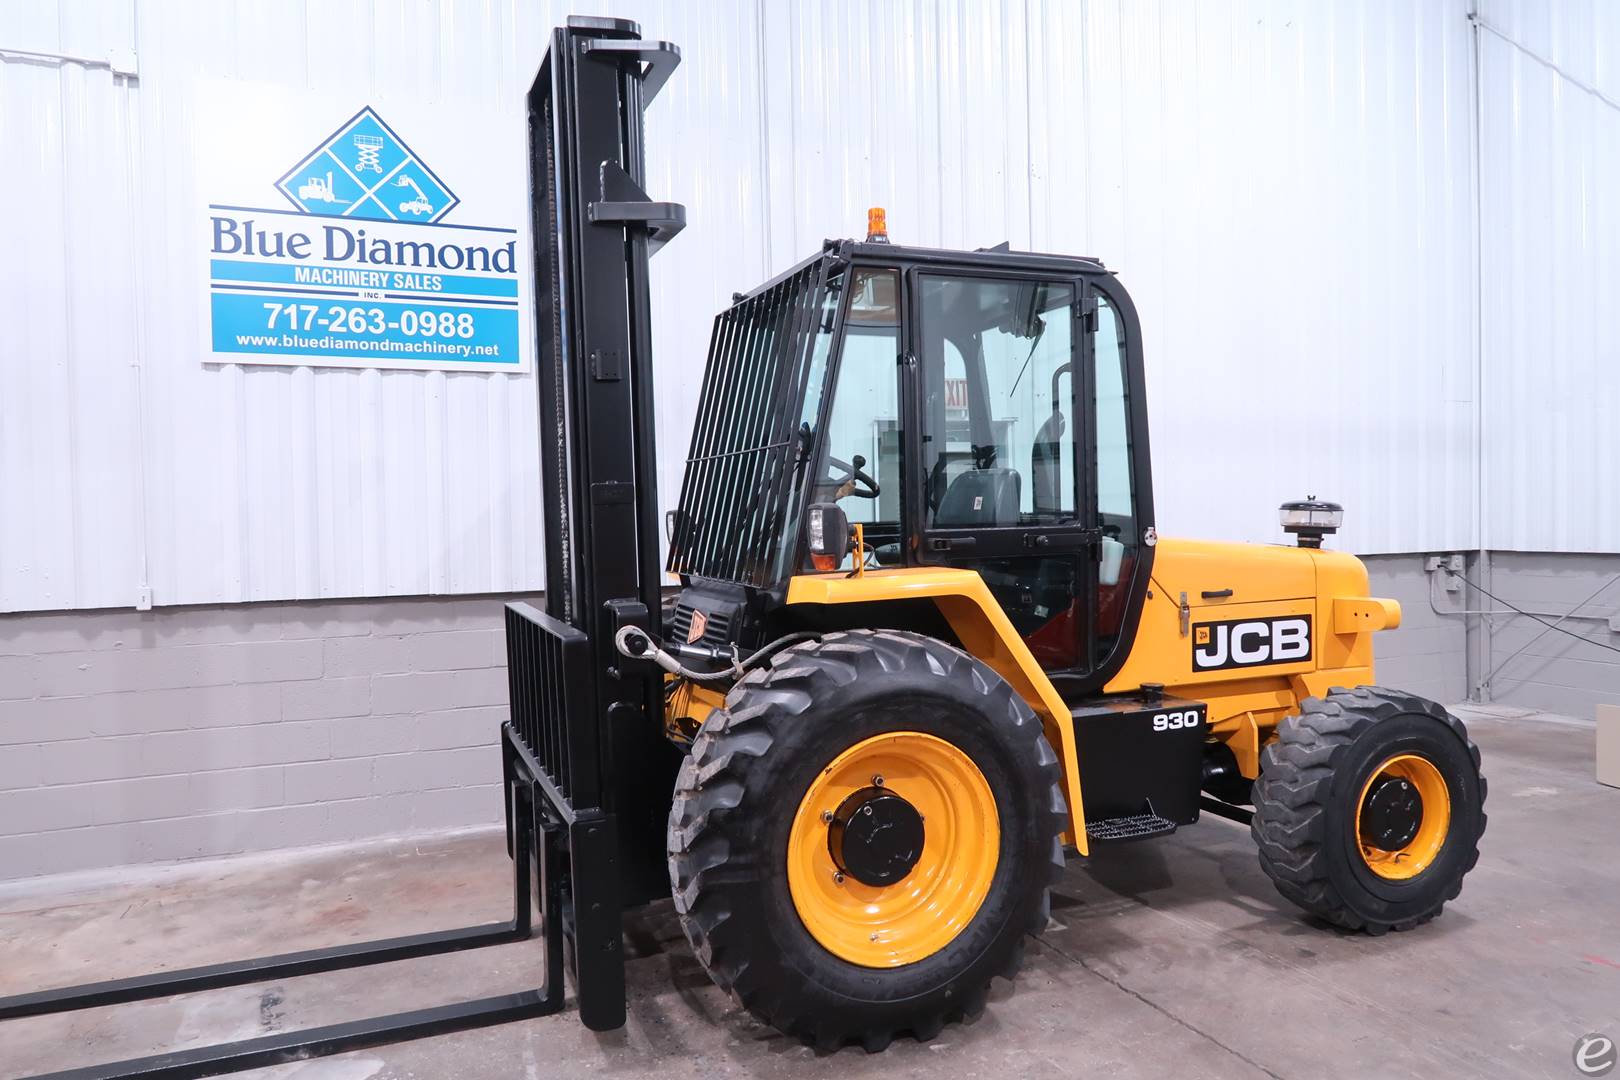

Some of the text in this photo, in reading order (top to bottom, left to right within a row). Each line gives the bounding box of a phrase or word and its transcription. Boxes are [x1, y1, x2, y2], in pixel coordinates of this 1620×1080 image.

[210, 216, 517, 274] Blue Diamond
[294, 266, 442, 291] MACHINERY SALES
[263, 303, 474, 339] 717-263-0988
[236, 334, 499, 358] www.bluediamondmachinery.net
[944, 380, 968, 407] XIT
[1195, 619, 1310, 668] JCB
[1153, 711, 1199, 732] 930
